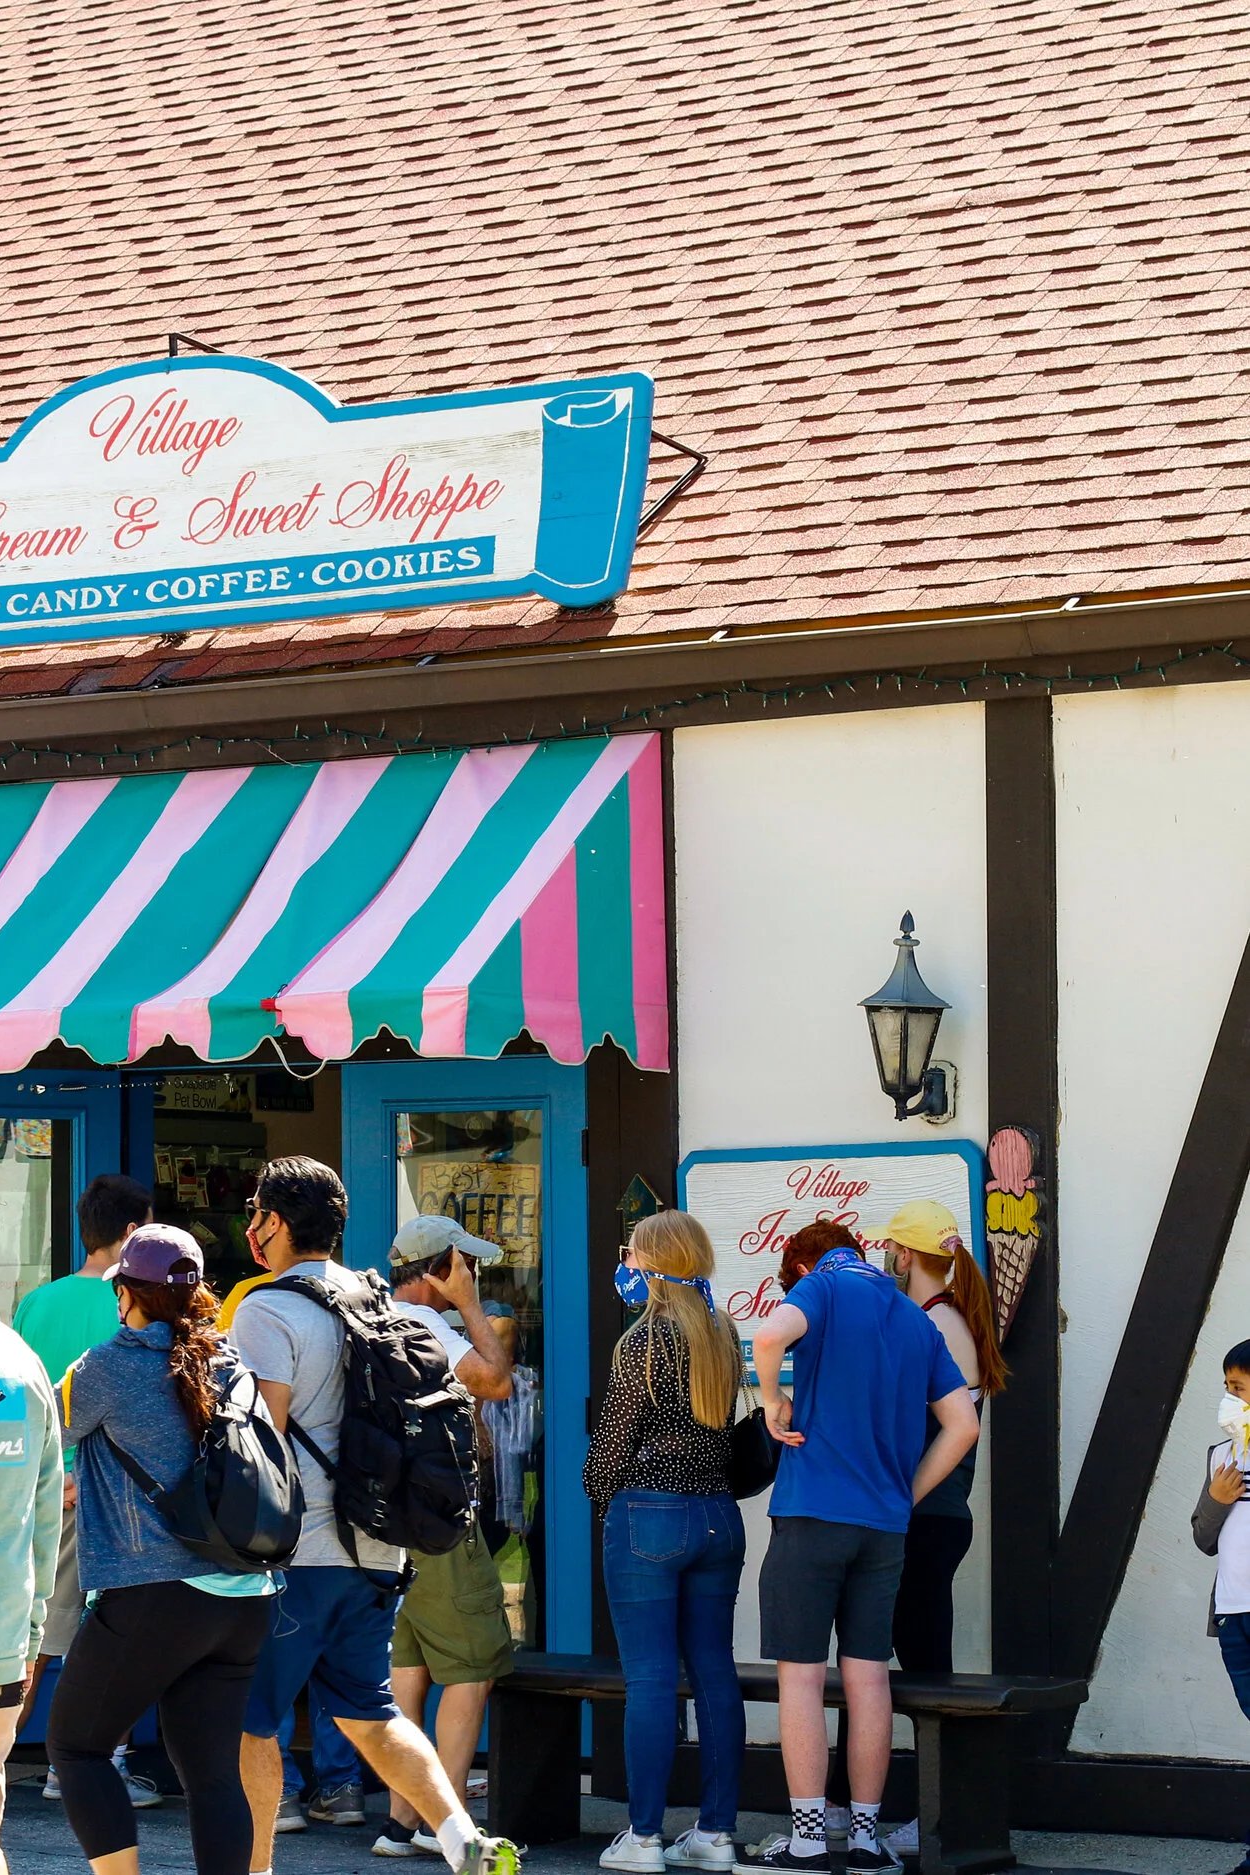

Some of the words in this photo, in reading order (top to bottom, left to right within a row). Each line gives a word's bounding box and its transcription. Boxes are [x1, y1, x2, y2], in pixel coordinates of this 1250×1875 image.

[88, 387, 244, 476] Village
[113, 496, 158, 552] &
[180, 470, 327, 546] Sweet
[330, 454, 506, 543] Shoppe
[5, 583, 124, 618] CANDY
[143, 567, 292, 604] COFFEE
[311, 546, 482, 588] COOKIES
[174, 1092, 191, 1108] Pet
[192, 1093, 217, 1109] Bowl
[786, 1163, 871, 1210] Village
[798, 1831, 826, 1842] VANS
